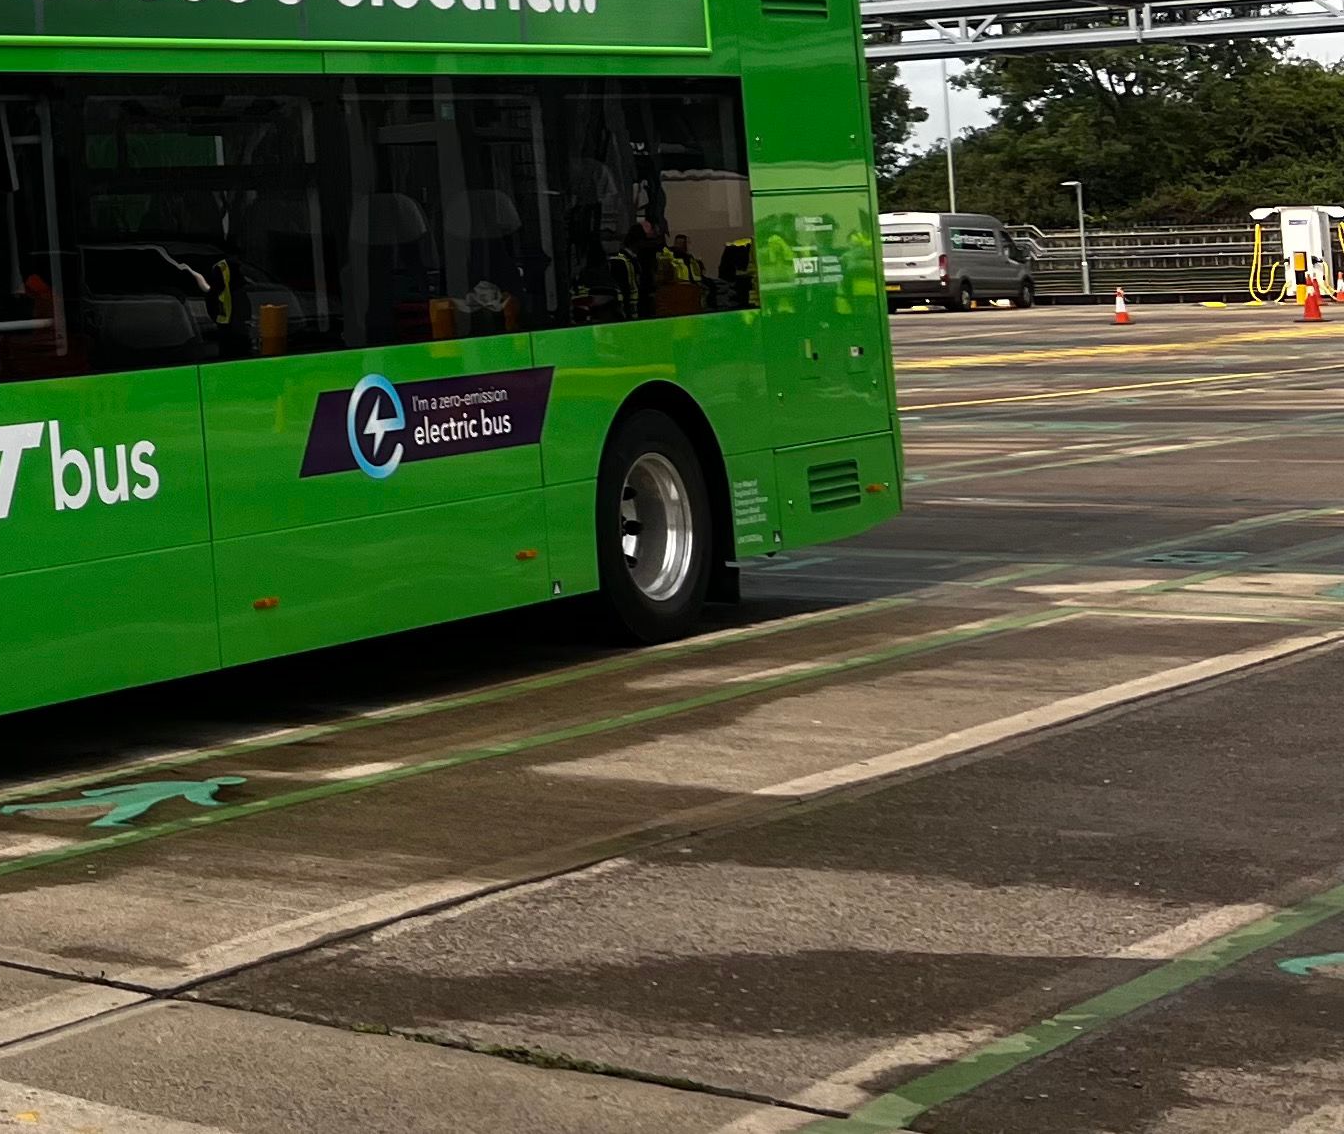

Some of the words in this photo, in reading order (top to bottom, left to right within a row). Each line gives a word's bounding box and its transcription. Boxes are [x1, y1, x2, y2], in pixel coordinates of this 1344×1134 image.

[412, 395, 429, 412] I'm
[431, 398, 438, 410] a
[414, 415, 479, 446] electric
[481, 409, 512, 436] bus
[49, 420, 160, 511] bus
